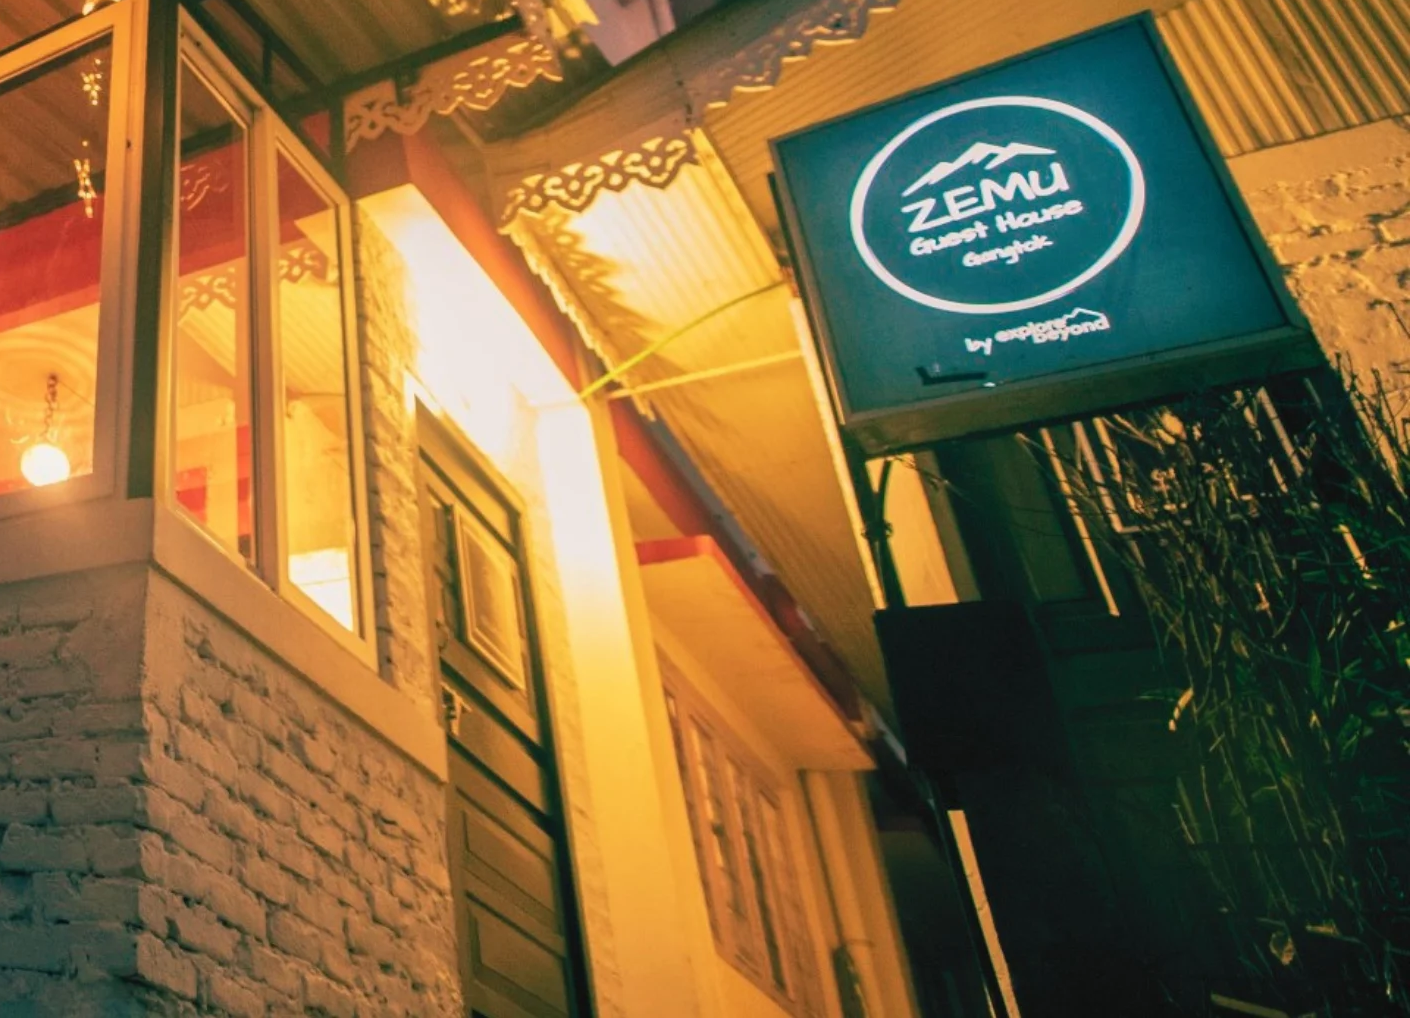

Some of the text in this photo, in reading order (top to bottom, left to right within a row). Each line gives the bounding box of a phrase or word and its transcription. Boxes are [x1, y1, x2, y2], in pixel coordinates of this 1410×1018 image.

[901, 162, 1070, 232] ZEMU
[909, 200, 1084, 256] Guest House
[962, 234, 1054, 268] Gangtok
[964, 317, 1067, 356] by explore
[1032, 313, 1111, 344] beyond
